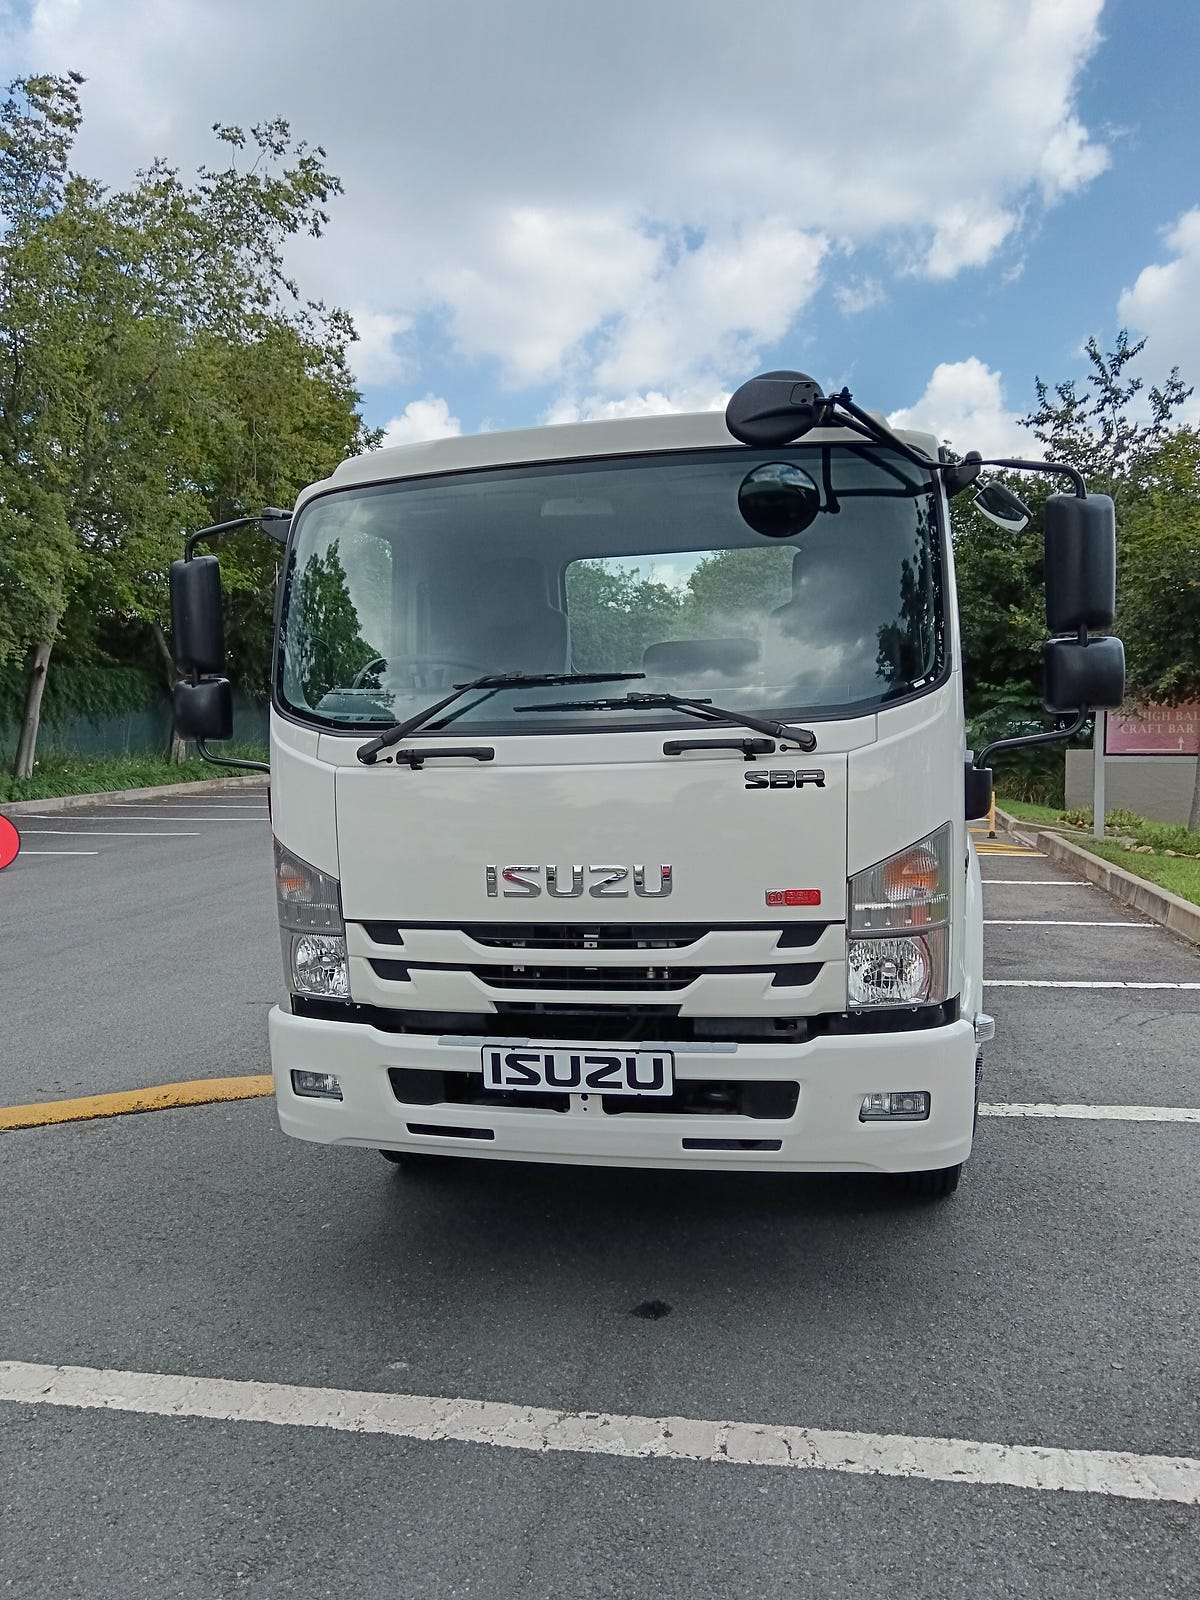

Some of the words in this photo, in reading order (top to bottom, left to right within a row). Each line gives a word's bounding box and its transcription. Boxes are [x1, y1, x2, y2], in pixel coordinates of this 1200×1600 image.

[1120, 723, 1162, 734] CRAFT
[1168, 723, 1195, 734] BAR
[744, 770, 826, 789] SBR
[486, 864, 673, 898] ISUZU
[491, 1052, 664, 1090] ISUZU
